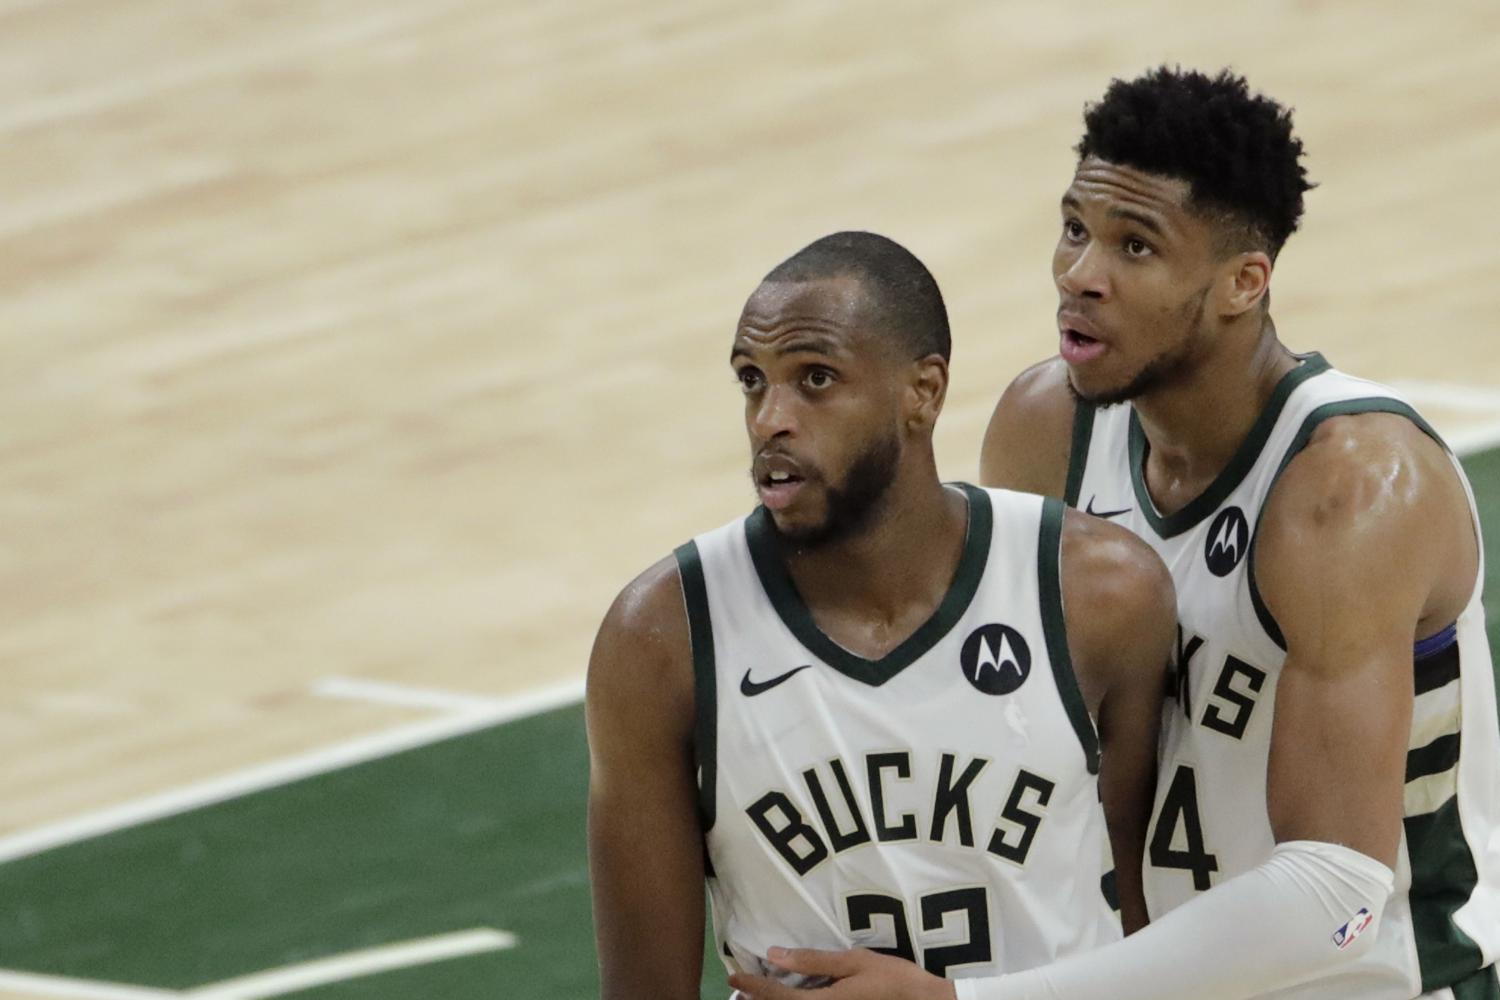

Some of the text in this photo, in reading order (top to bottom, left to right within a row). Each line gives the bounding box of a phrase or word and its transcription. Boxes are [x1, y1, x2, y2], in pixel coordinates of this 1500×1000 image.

[1163, 624, 1267, 740] KS
[746, 752, 1056, 877] BUCKS
[846, 888, 992, 979] 22
